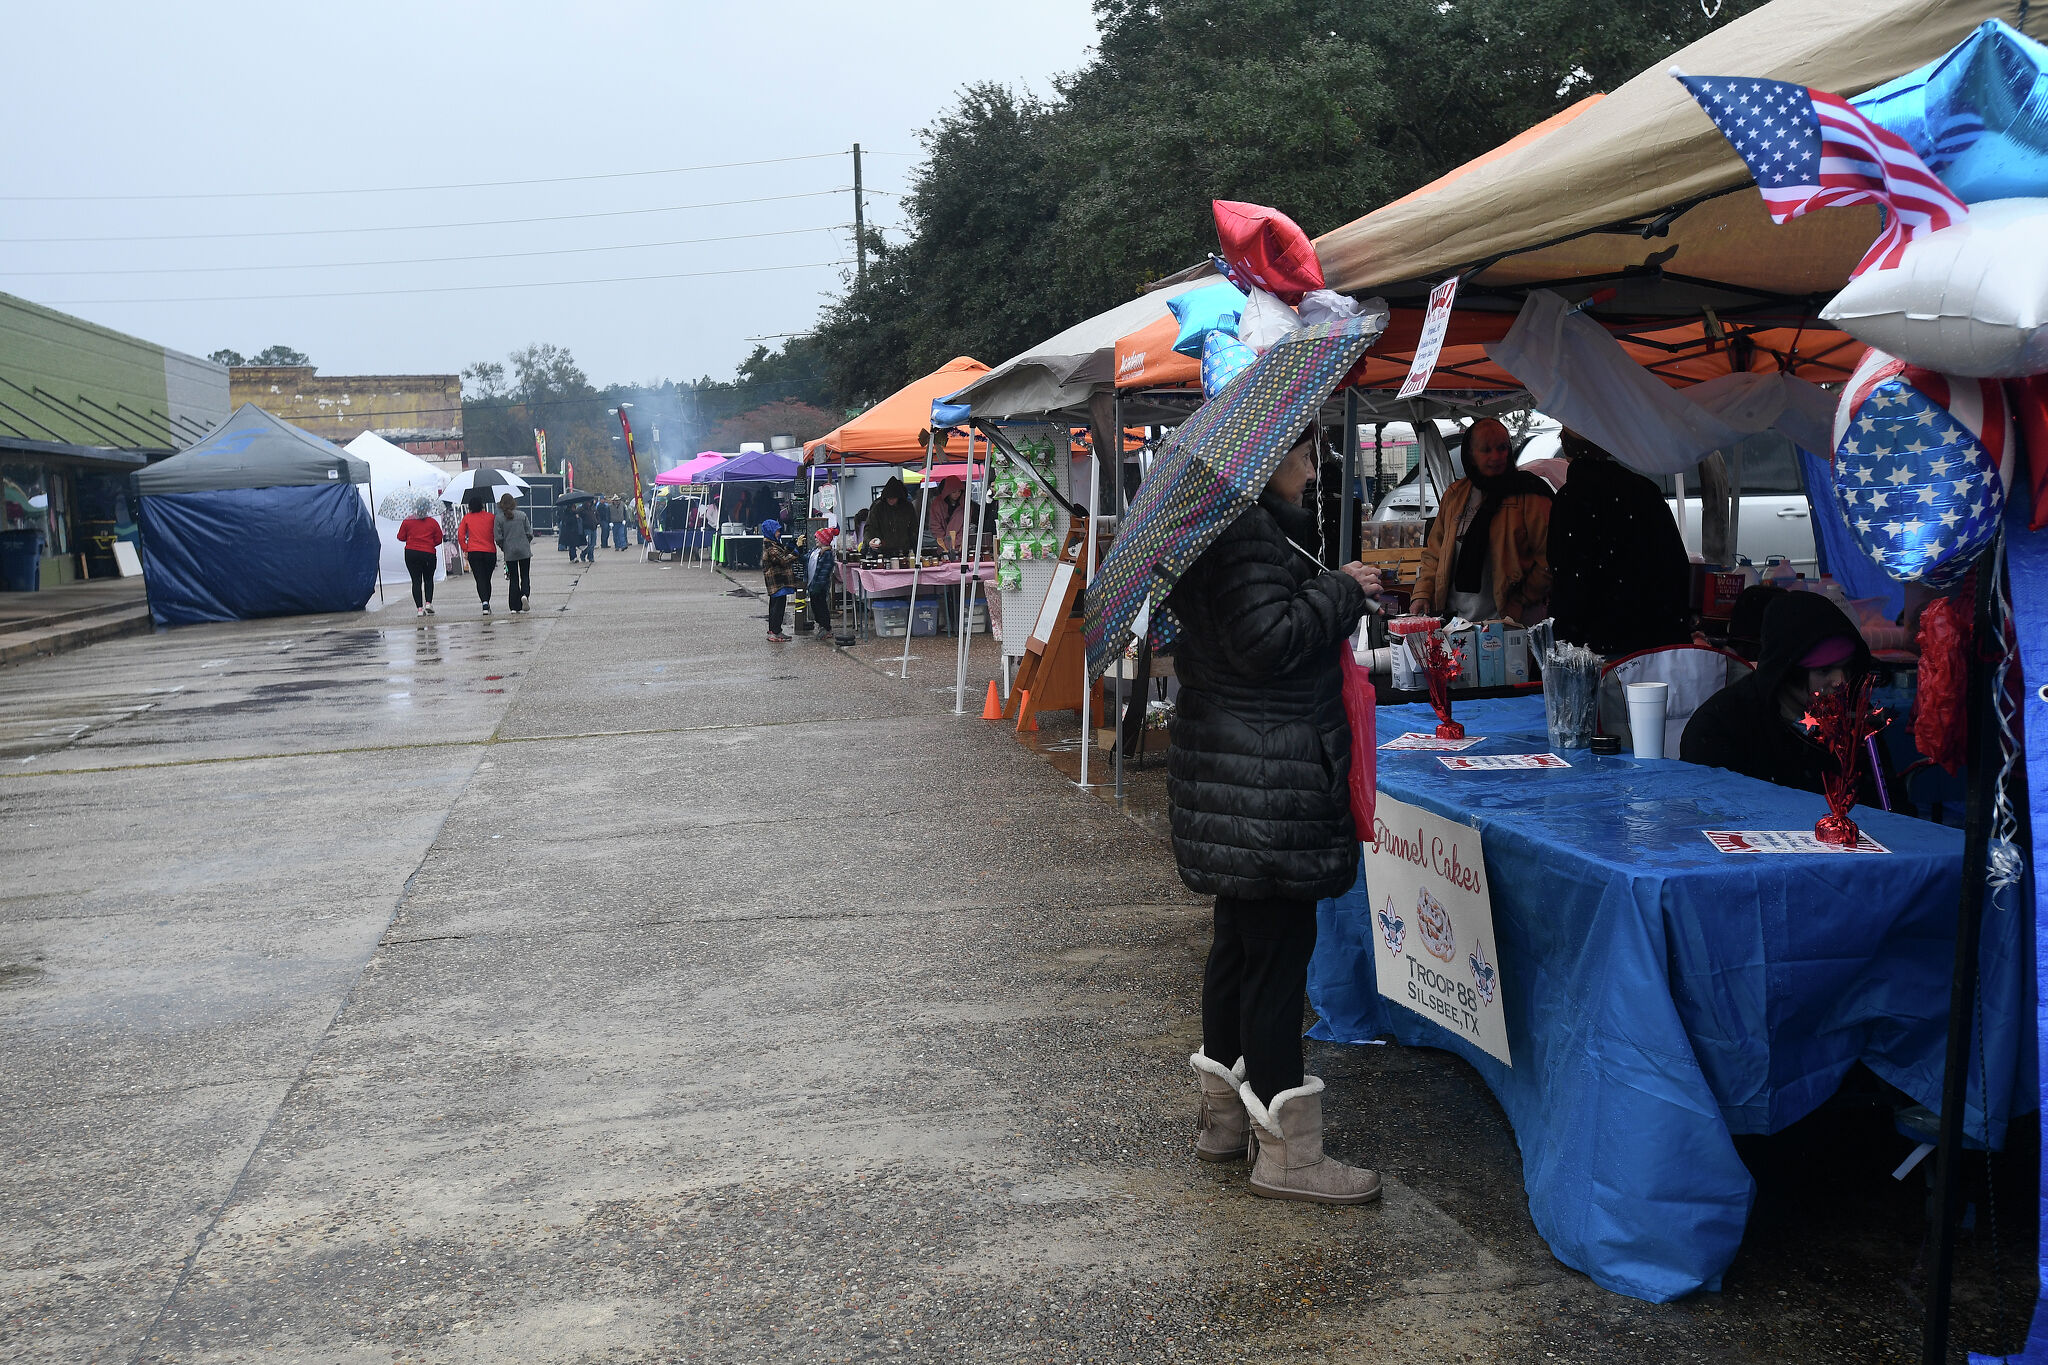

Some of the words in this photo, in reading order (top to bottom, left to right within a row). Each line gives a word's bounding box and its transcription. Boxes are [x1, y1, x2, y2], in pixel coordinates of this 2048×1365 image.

[1371, 817, 1428, 868] Funnel
[1432, 836, 1482, 895] Cakes
[1405, 953, 1455, 998] TROOP
[1457, 982, 1478, 1013] 88
